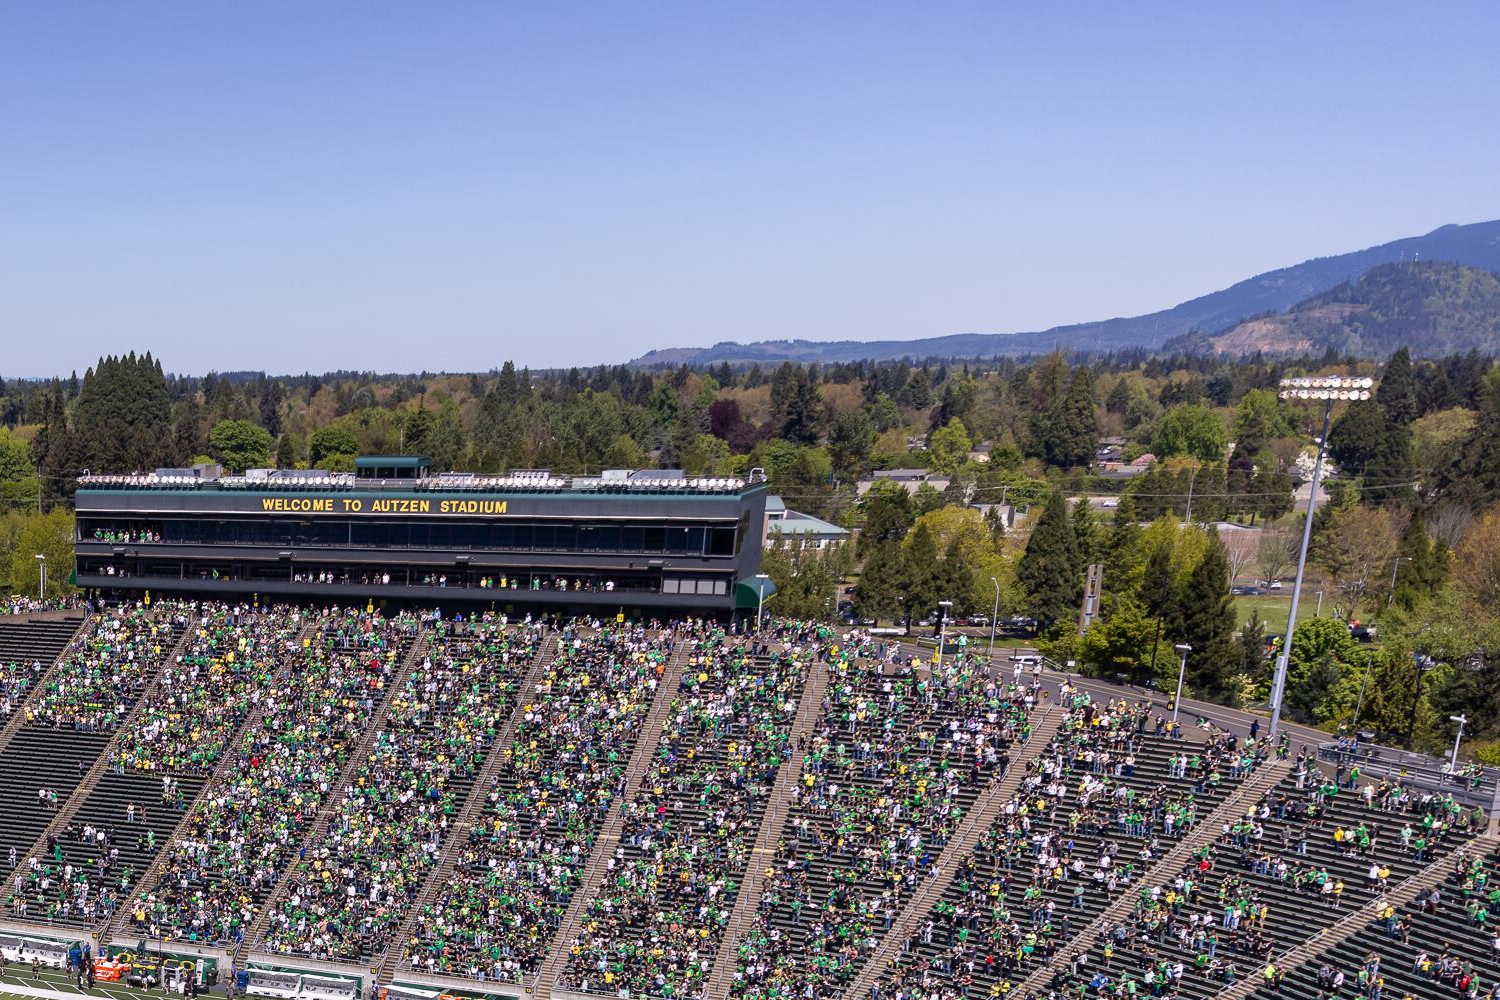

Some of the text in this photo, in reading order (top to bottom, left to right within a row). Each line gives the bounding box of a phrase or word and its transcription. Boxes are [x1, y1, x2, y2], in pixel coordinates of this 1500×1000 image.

[262, 498, 508, 513] WELCOME TO AUTZEN STADIUM
